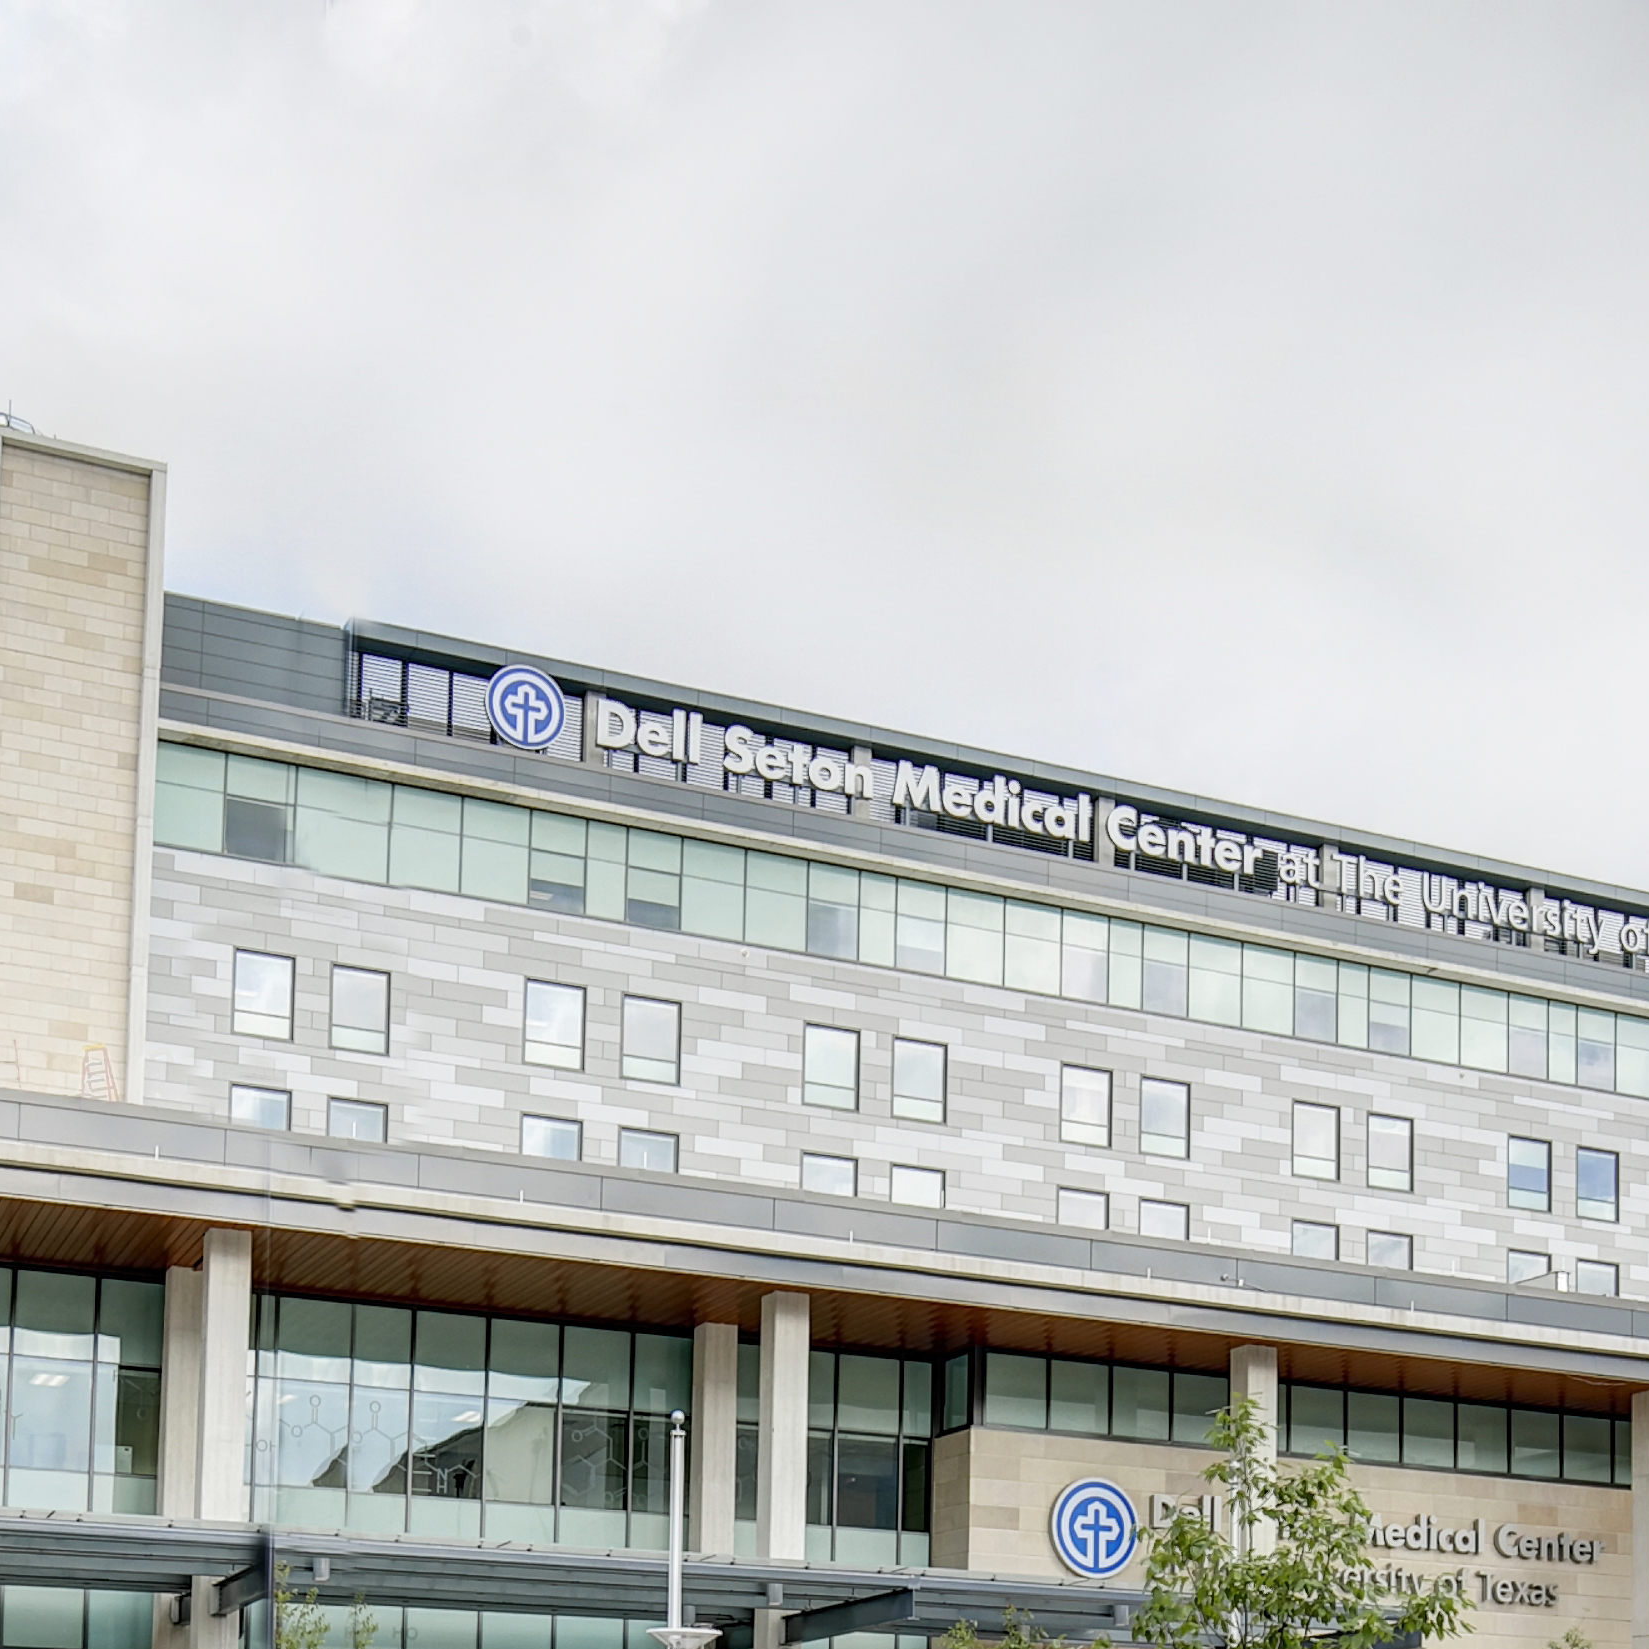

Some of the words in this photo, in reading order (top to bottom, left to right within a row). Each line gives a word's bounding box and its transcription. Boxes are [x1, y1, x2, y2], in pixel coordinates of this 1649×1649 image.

[596, 697, 702, 766] Dell
[722, 724, 874, 801] Seton
[892, 759, 1091, 843] Medical
[1105, 804, 1264, 876] Center
[1278, 851, 1320, 890] at
[1333, 854, 1403, 906] The
[1421, 870, 1605, 955] University
[1348, 1511, 1485, 1555] Medical
[1494, 1522, 1605, 1566] Center
[1434, 1567, 1468, 1600] of
[1476, 1569, 1560, 1606] Texas
